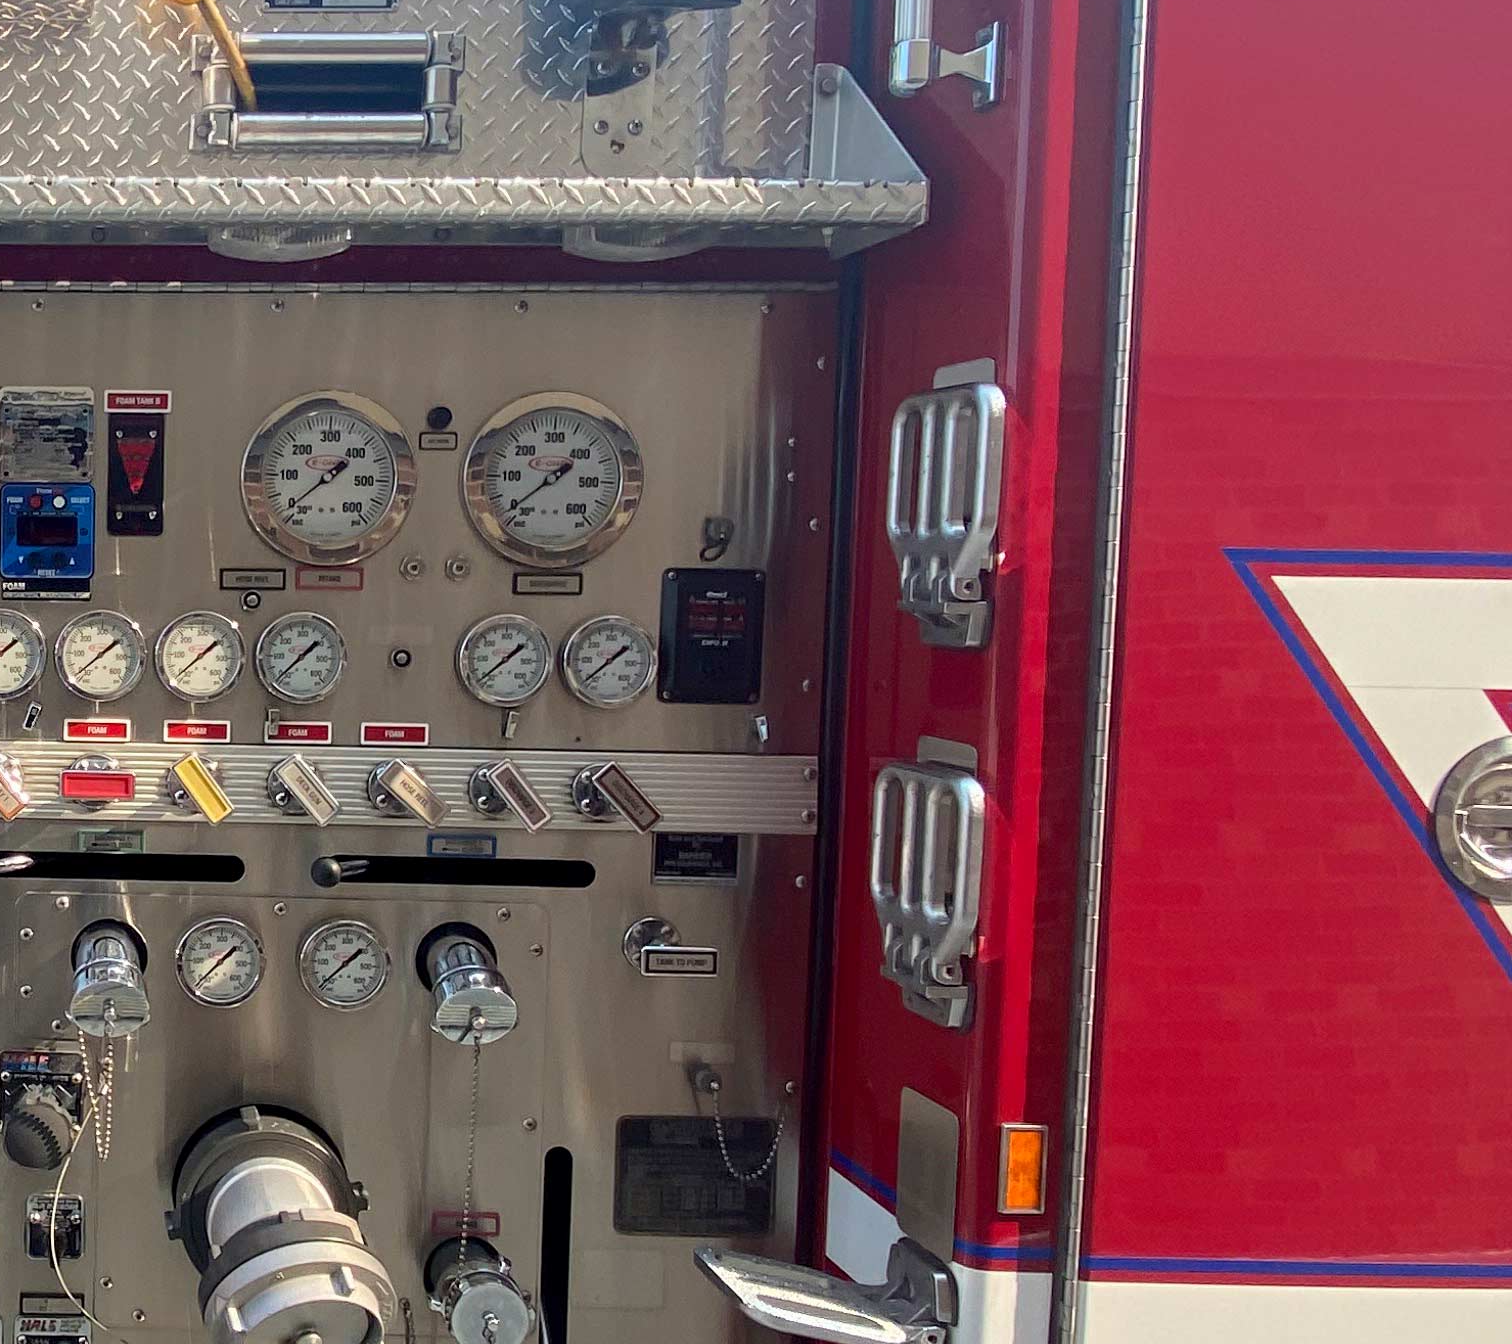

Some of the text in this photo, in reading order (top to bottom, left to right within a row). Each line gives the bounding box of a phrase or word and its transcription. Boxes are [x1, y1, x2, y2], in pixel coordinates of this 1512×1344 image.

[115, 396, 136, 405] FOAM
[137, 397, 154, 406] TANK
[320, 430, 341, 443] 300
[544, 432, 565, 443] 300
[292, 444, 312, 455] 200
[345, 447, 366, 459] 400
[515, 445, 536, 456] 200
[569, 448, 591, 460] 400
[280, 469, 298, 480] 100
[502, 471, 521, 482] 100
[354, 475, 374, 487] 500
[578, 476, 599, 488] 500
[288, 497, 296, 508] 0
[342, 502, 363, 513] 600
[565, 503, 587, 515] 600
[2, 582, 26, 591] FOAM
[296, 630, 309, 638] 300
[180, 636, 192, 644] 200
[73, 649, 85, 657] 100
[316, 655, 328, 663] 500
[9, 665, 22, 673] 600
[109, 667, 121, 675] 600
[87, 725, 108, 735] FOAM
[187, 726, 208, 736] FOAM
[288, 728, 308, 738] FOAM
[385, 729, 405, 739] FOAM
[399, 778, 418, 798] HOSE
[199, 942, 212, 950] 200
[235, 960, 248, 968] 500
[317, 958, 329, 966] 100
[676, 958, 686, 967] TO
[229, 974, 242, 982] 600
[20, 1319, 57, 1333] HALE
